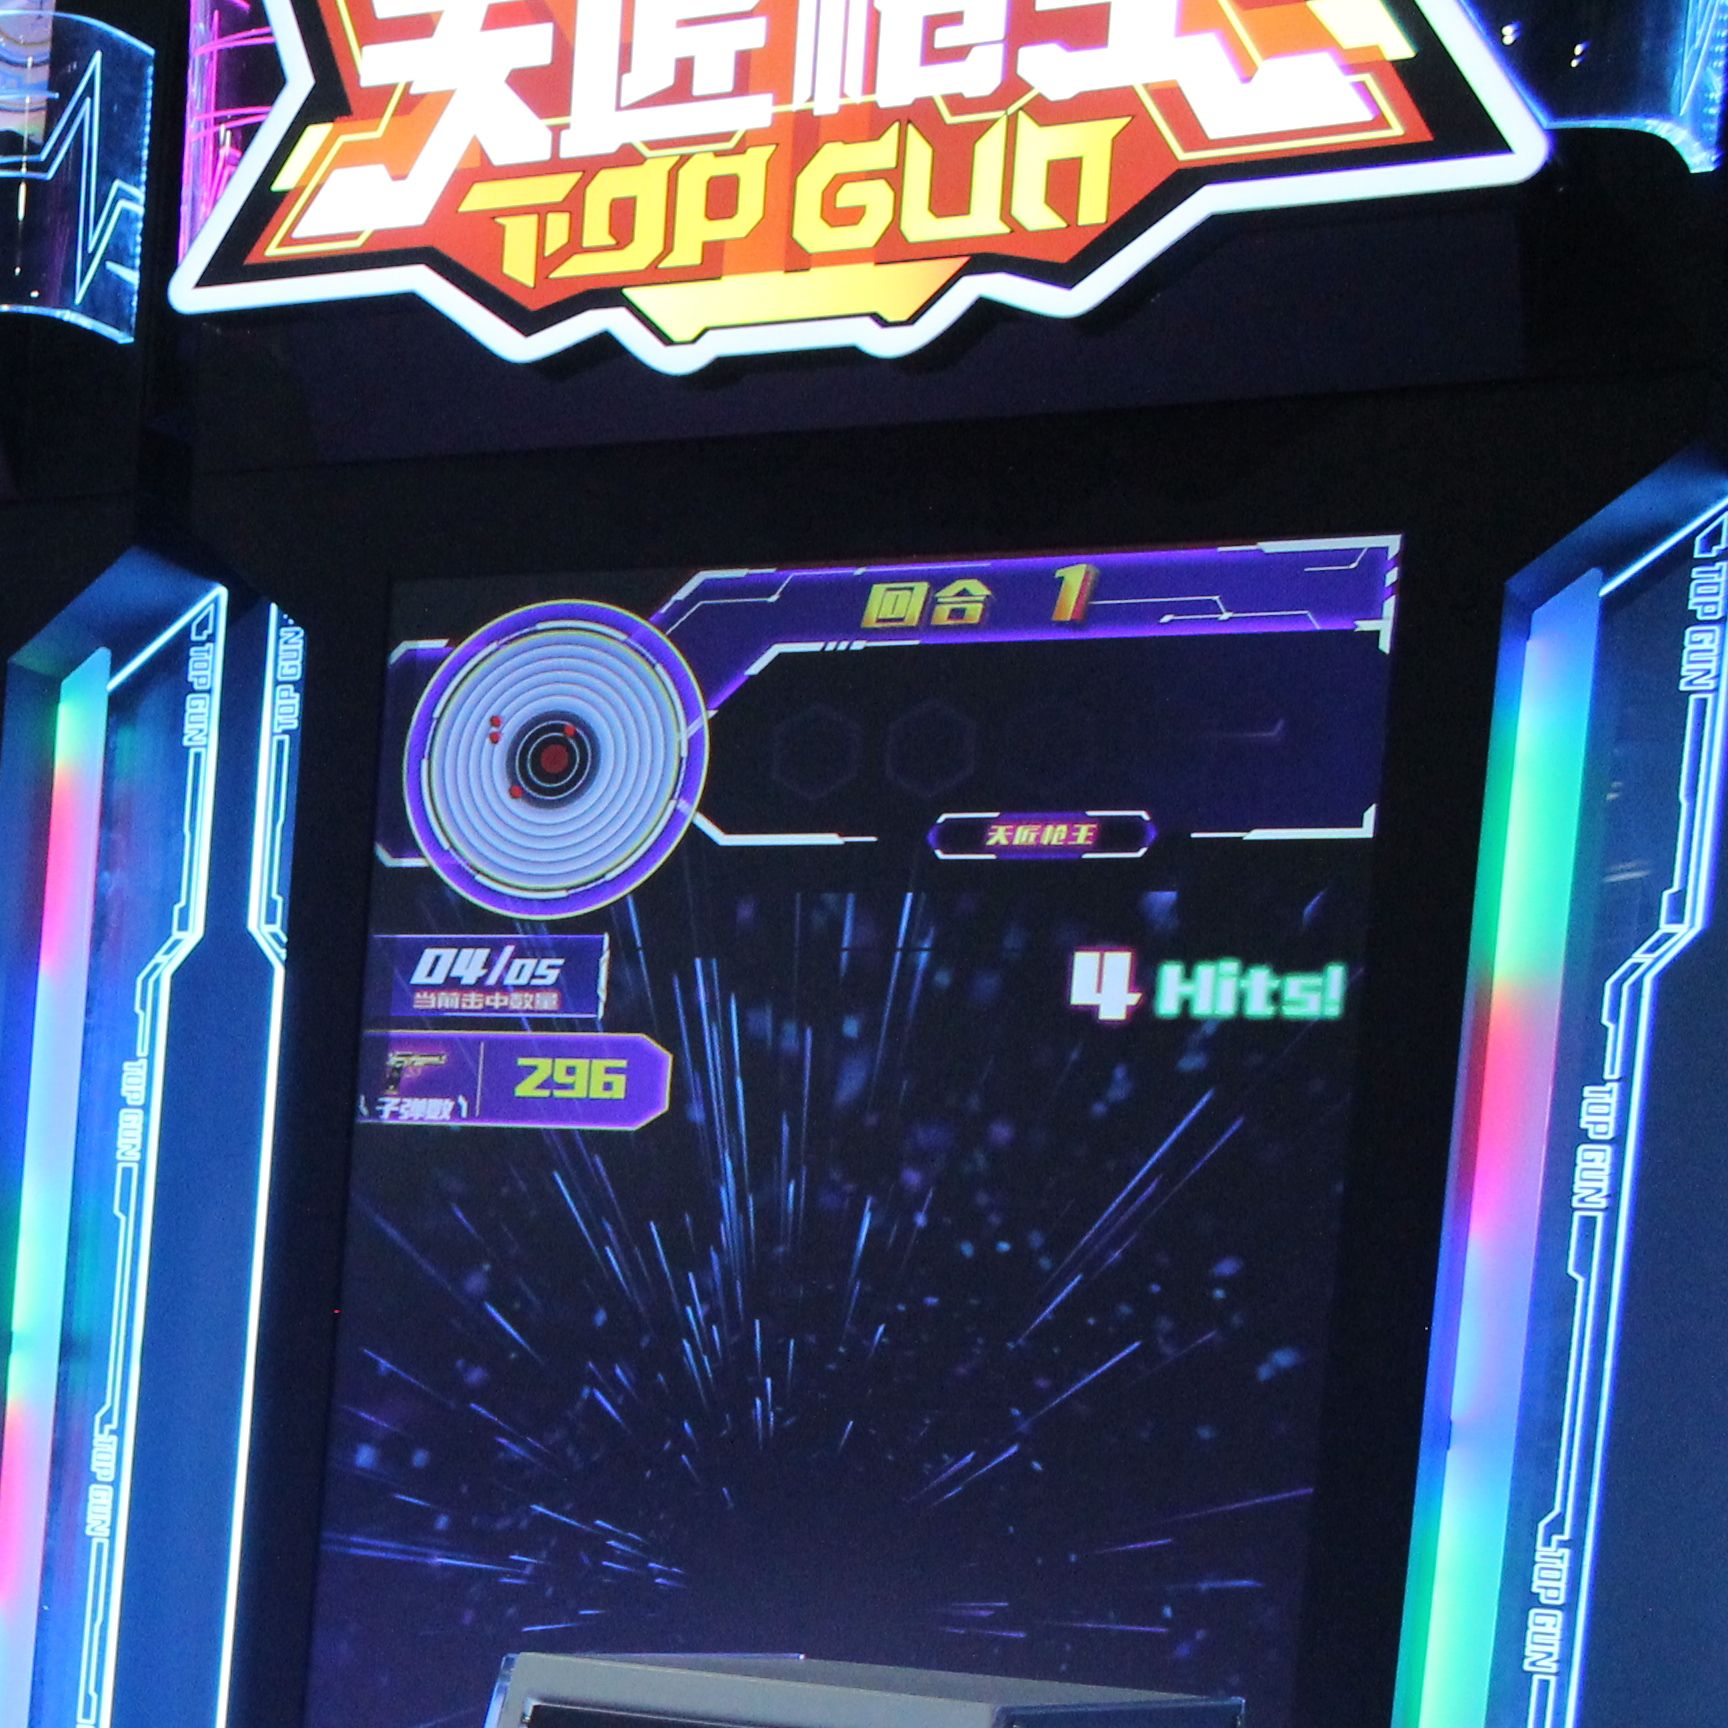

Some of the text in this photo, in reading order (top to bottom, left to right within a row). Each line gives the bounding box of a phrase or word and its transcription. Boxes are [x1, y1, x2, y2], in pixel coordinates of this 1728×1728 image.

[458, 111, 1134, 289] TOP GUN
[861, 564, 1100, 629] 回合 1
[1678, 561, 1727, 691] TOP GUN
[183, 642, 214, 747] TOP GUN
[274, 626, 305, 733] TOP GUN
[984, 821, 1098, 851] 天匠枪王
[409, 944, 565, 988] 04/05
[1070, 949, 1346, 1021] 4 Hits!
[116, 1058, 147, 1160] TOP GUN
[514, 1056, 628, 1100] 296
[1571, 1083, 1618, 1209] TOP GUN
[85, 1437, 117, 1537] TOP GUN
[1523, 1548, 1570, 1673] TOP GUN
